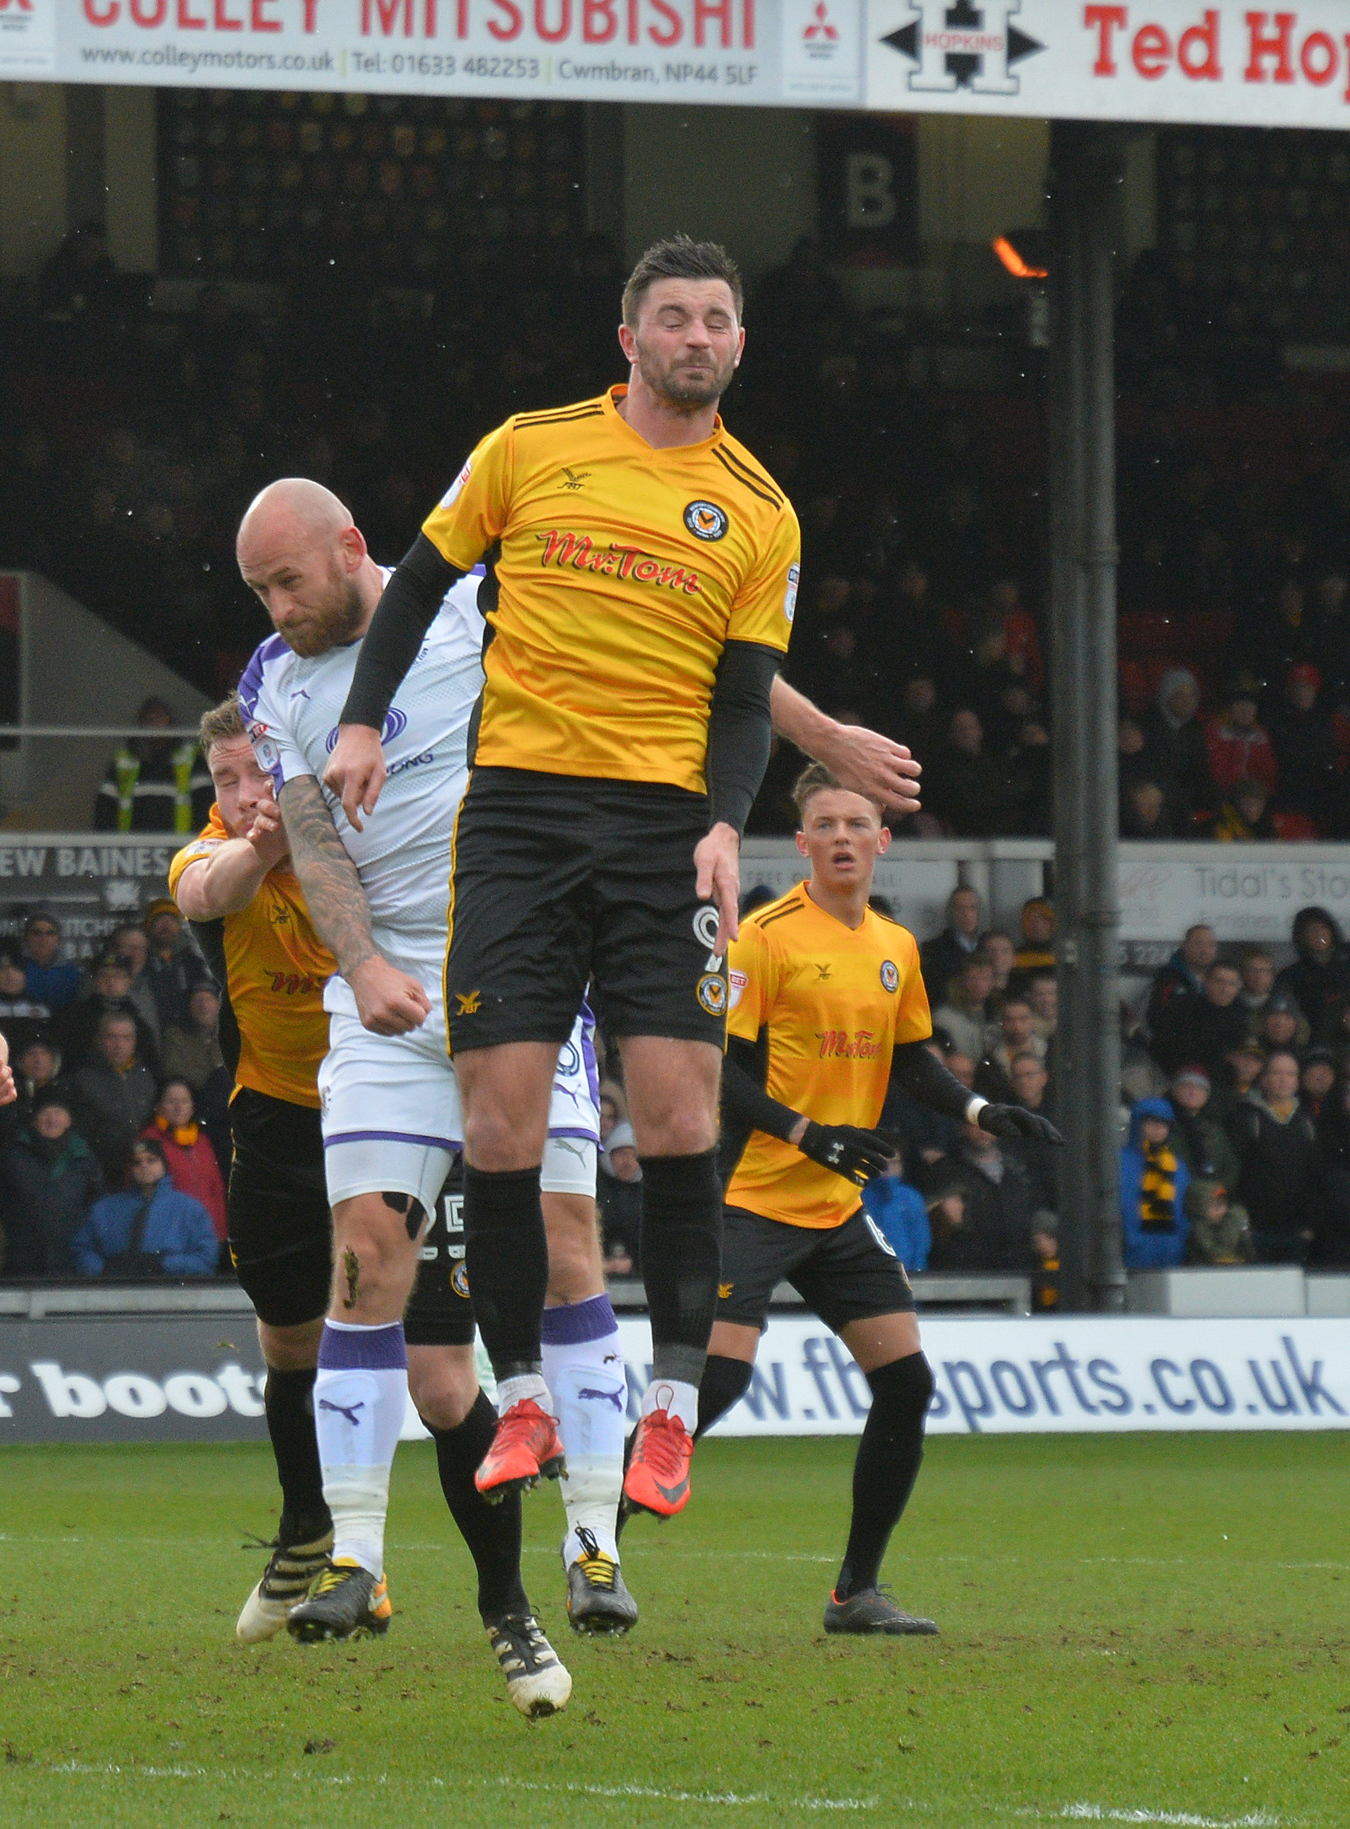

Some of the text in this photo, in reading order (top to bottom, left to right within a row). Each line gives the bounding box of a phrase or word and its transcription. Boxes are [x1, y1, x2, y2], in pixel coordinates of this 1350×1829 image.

[925, 32, 1004, 52] HOPKINS
[1083, 4, 1350, 105] Ted Ho
[81, 45, 335, 73] www.colleymotors.co.uk
[391, 53, 456, 76] 01633
[463, 57, 540, 79] 482253
[664, 62, 719, 83] NP44
[56, 850, 169, 877] BAINES
[1194, 866, 1292, 899] Tidal's
[32, 1363, 264, 1420] boot
